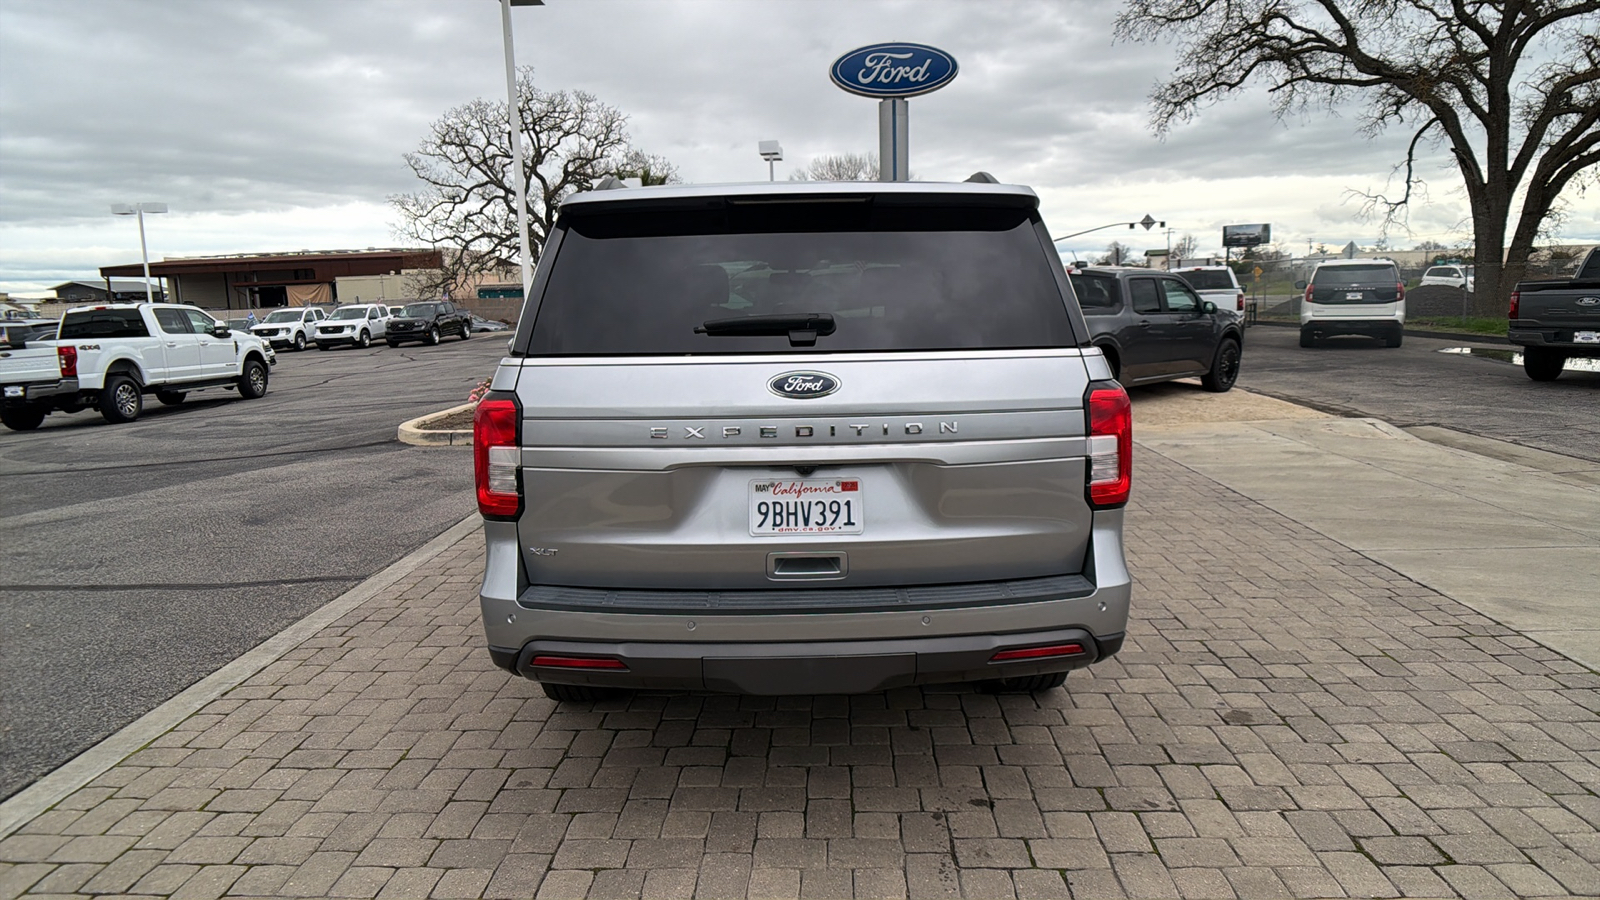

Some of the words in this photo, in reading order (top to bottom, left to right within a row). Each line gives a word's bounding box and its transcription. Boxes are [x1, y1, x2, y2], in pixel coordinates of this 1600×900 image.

[857, 52, 932, 84] Ford
[783, 375, 824, 392] Ford
[650, 421, 958, 439] EXPEDITION
[755, 484, 770, 493] MAY
[772, 481, 842, 499] California
[757, 500, 856, 528] 9BHV391
[529, 547, 559, 556] XLT
